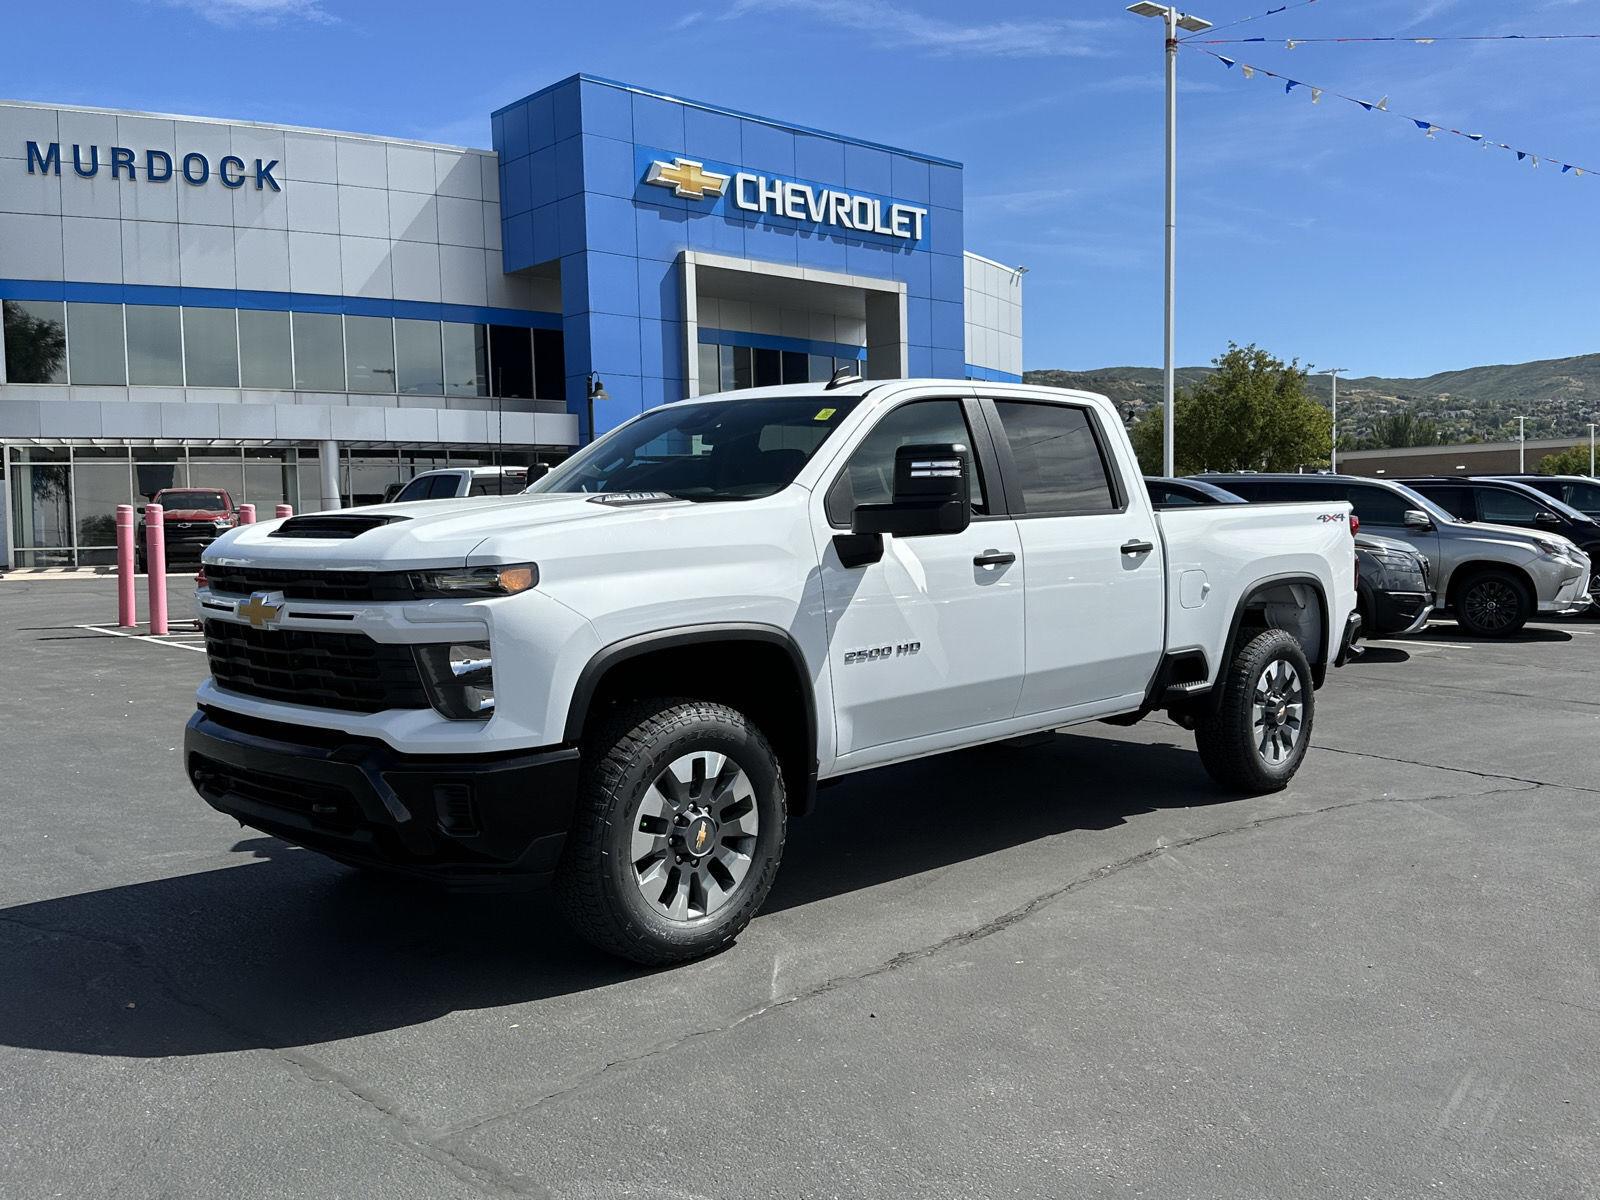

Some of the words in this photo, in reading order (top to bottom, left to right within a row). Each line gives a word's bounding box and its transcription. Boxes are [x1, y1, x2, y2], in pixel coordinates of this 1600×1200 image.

[26, 140, 282, 193] MURDOCK
[735, 172, 928, 241] CHEVROLET
[843, 646, 893, 664] 2500
[896, 641, 921, 656] HD
